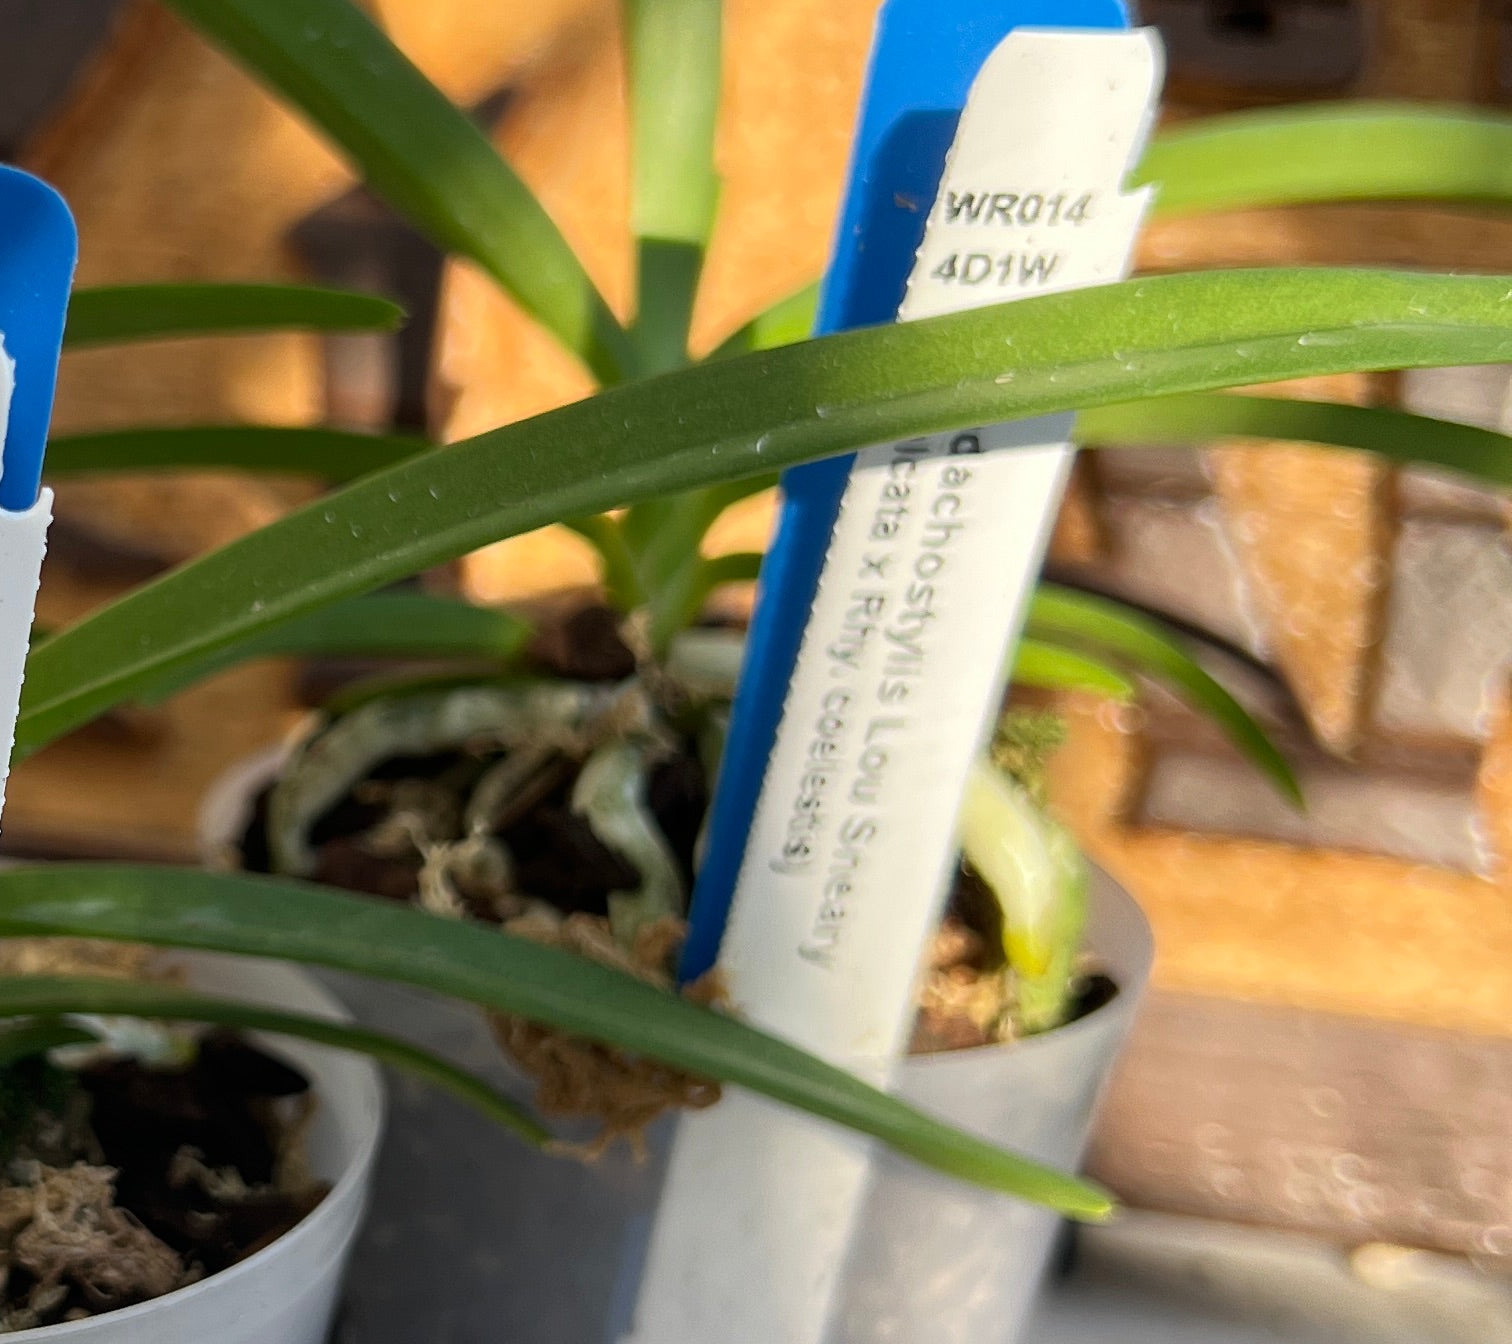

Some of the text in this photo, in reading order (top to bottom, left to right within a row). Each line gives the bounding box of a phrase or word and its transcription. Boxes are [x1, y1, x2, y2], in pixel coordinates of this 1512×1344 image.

[943, 191, 1094, 227] WR014
[930, 254, 1062, 287] 4D1W
[857, 553, 890, 579] x
[826, 589, 885, 678] Rhy.
[768, 687, 857, 874] coelestis)
[849, 717, 908, 805] Lou
[797, 815, 878, 971] Sneary
